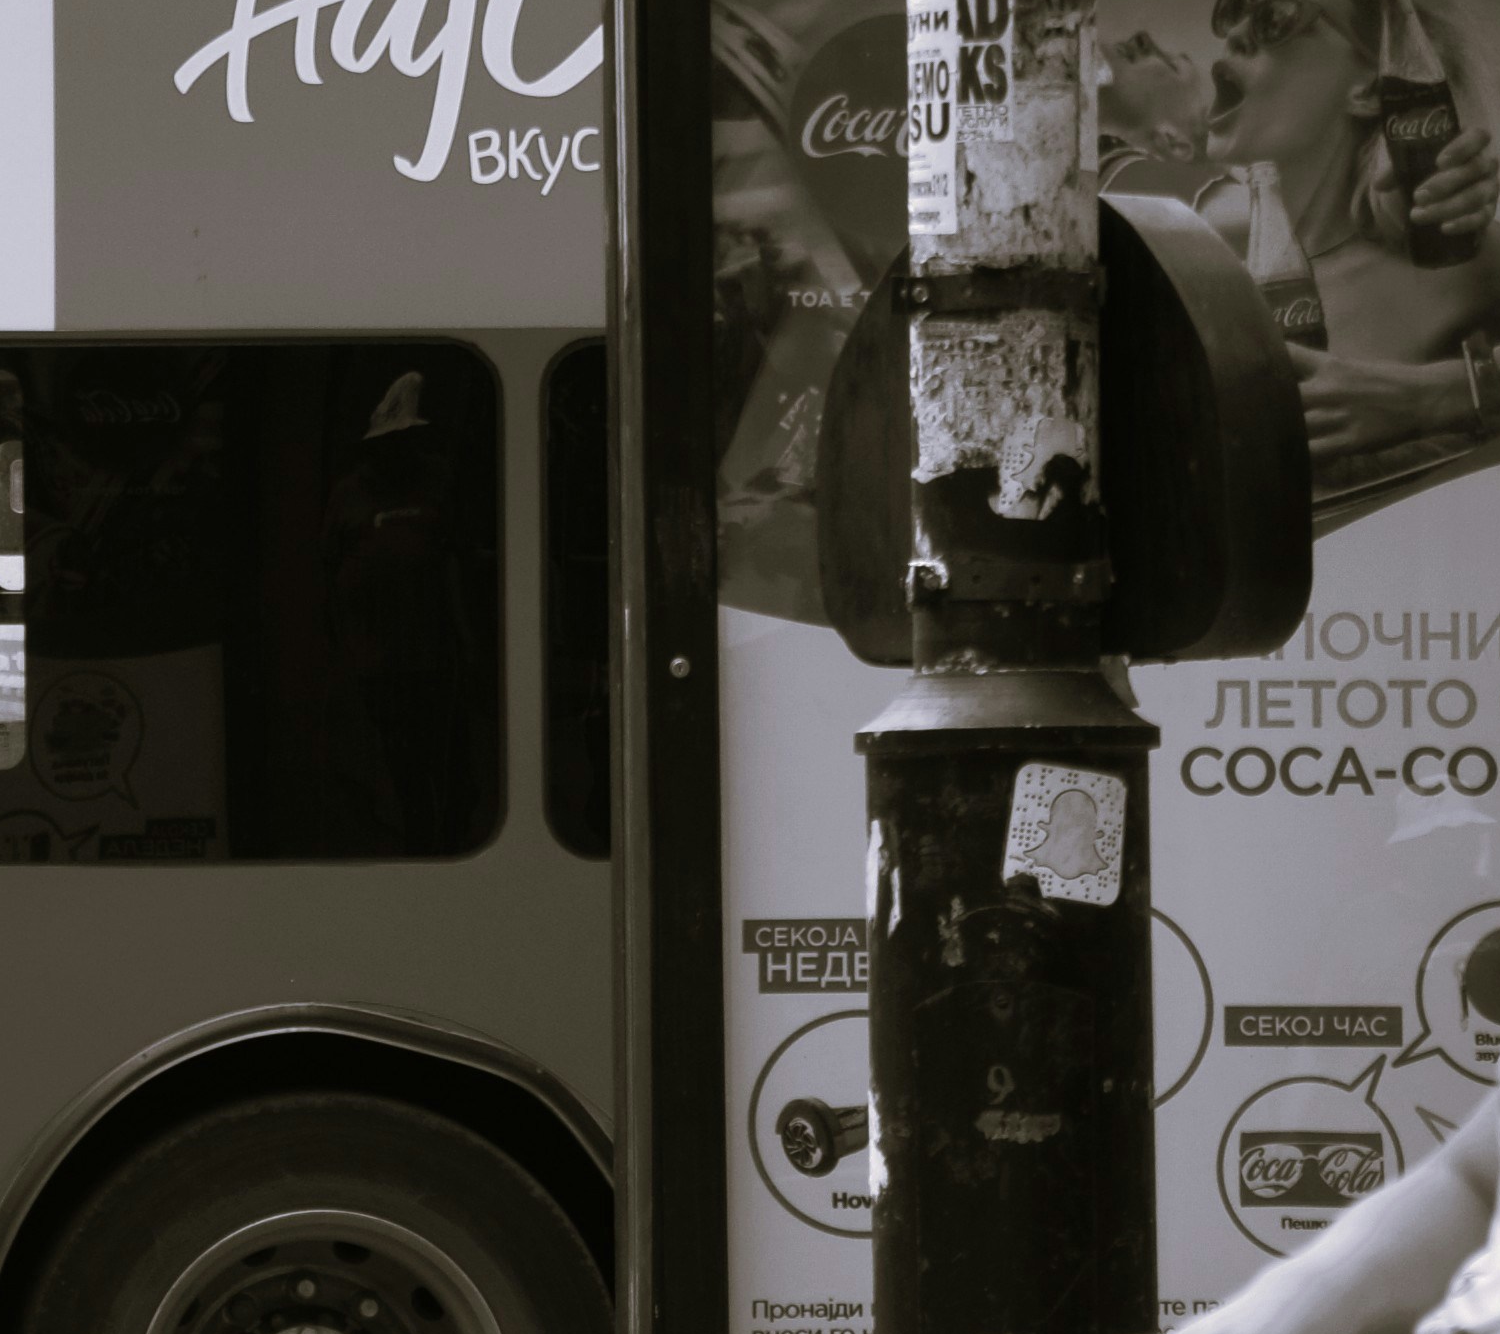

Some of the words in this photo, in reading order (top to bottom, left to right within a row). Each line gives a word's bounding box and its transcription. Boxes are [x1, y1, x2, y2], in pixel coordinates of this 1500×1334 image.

[801, 93, 896, 159] Coca
[1204, 679, 1480, 729] ЛЕТОТО
[754, 926, 860, 948] СЕКОЈА
[766, 951, 870, 988] НЕДЕ
[1239, 1015, 1326, 1037] СЕКОЈ
[1333, 1015, 1389, 1037] ЧАС
[832, 1191, 874, 1210] Hov
[750, 1299, 864, 1321] Пронајди
